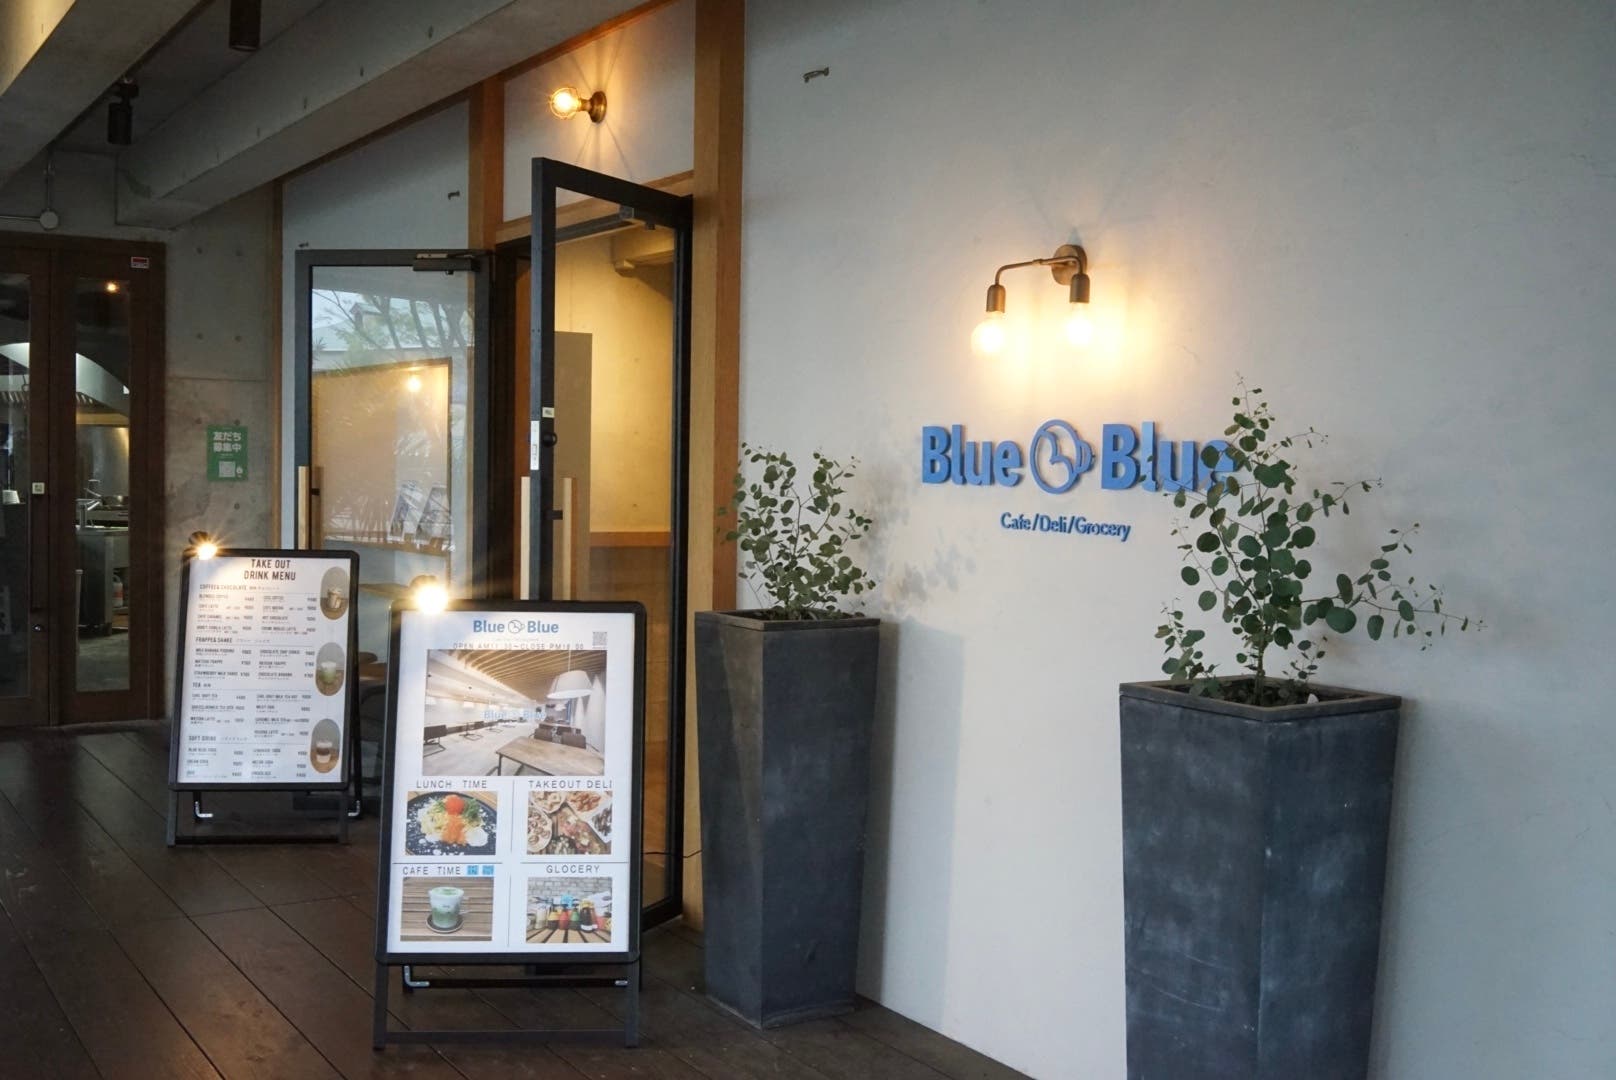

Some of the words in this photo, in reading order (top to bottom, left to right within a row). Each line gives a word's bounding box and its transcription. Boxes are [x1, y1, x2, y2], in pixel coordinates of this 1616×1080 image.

[213, 431, 242, 441] 友だち
[922, 424, 1023, 487] Blue
[251, 558, 272, 569] TAKE
[274, 559, 291, 569] OUT
[243, 570, 269, 580] DRINK
[272, 571, 297, 581] MENU
[473, 620, 505, 633] Blue
[527, 620, 559, 634] Blue
[416, 780, 452, 789] LUNCH
[463, 780, 487, 789] TIME
[528, 780, 581, 789] TAKEOUT
[586, 780, 613, 789] DELI
[402, 866, 429, 875] CAFE
[437, 866, 461, 875] TIME
[546, 865, 600, 874] GLOCERY
